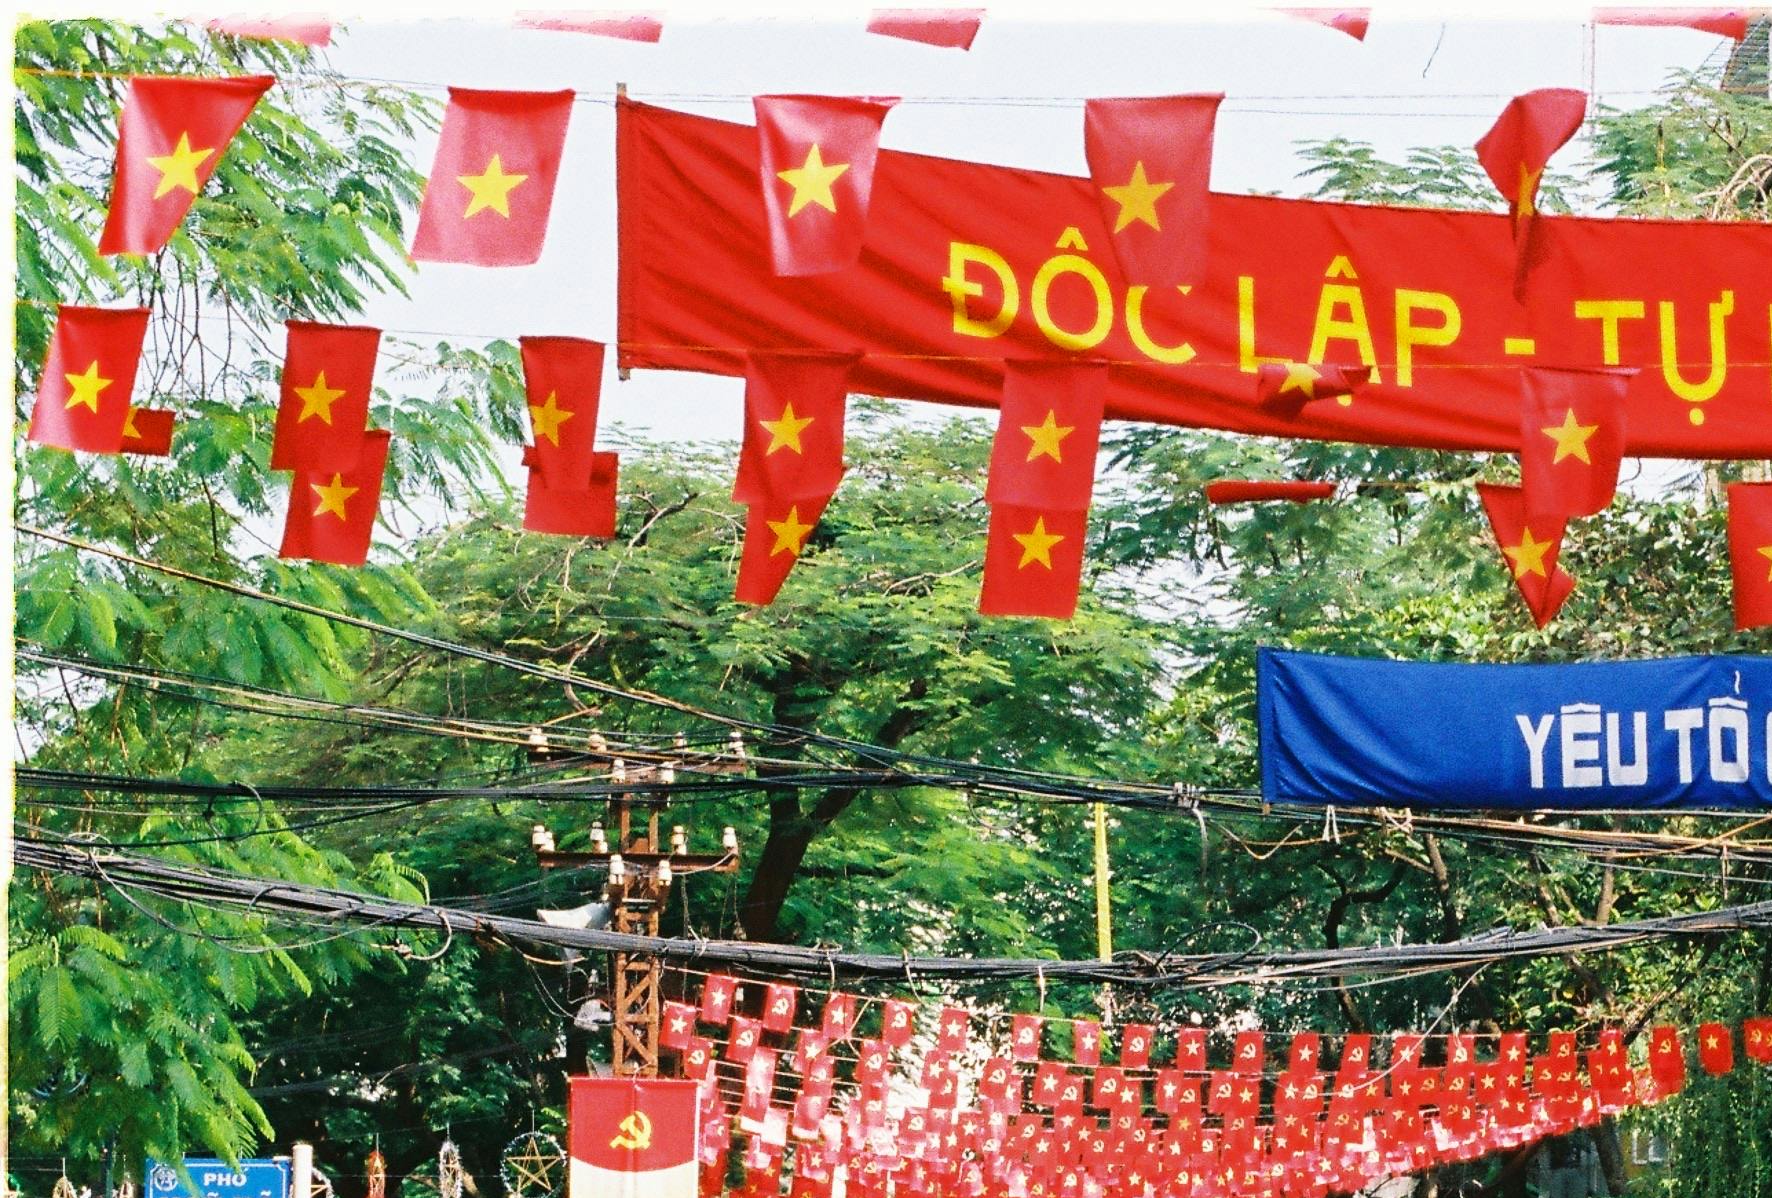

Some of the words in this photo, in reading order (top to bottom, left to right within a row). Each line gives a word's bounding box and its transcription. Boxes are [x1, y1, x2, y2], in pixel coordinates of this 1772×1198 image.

[1504, 338, 1535, 355] -
[1575, 290, 1734, 426] TỰ
[1515, 702, 1648, 789] YÊU
[1664, 670, 1749, 784] TỔ
